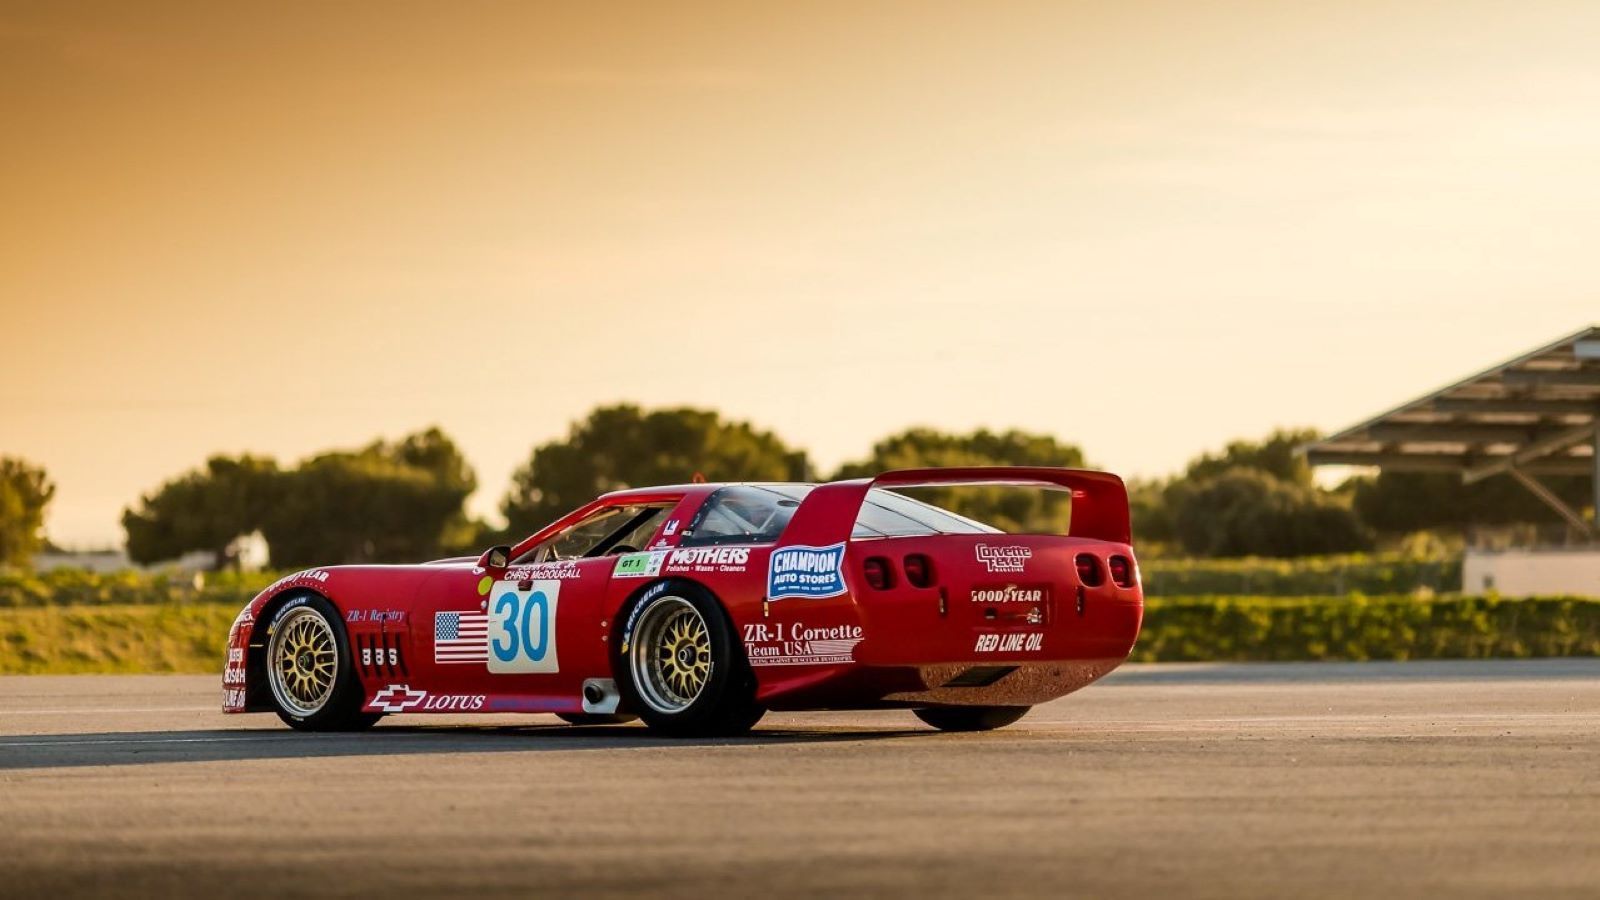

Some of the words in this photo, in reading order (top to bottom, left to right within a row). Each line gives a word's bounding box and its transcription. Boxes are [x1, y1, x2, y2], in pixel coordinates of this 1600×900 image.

[622, 559, 635, 568] GT
[668, 548, 751, 565] MOTHERS
[773, 552, 837, 573] CHAMPION
[504, 570, 531, 581] CHRIS
[773, 574, 798, 585] AUTO
[798, 573, 837, 583] STORES
[627, 582, 665, 630] MICHELIN
[492, 590, 549, 662] 30
[743, 623, 785, 642] ZR-1
[791, 622, 863, 641] Corvette
[744, 642, 780, 657] Team
[783, 641, 814, 656] USA
[974, 634, 999, 652] RED
[998, 633, 1026, 651] LINE
[1025, 633, 1044, 651] OIL
[423, 694, 486, 710] LOTUS
